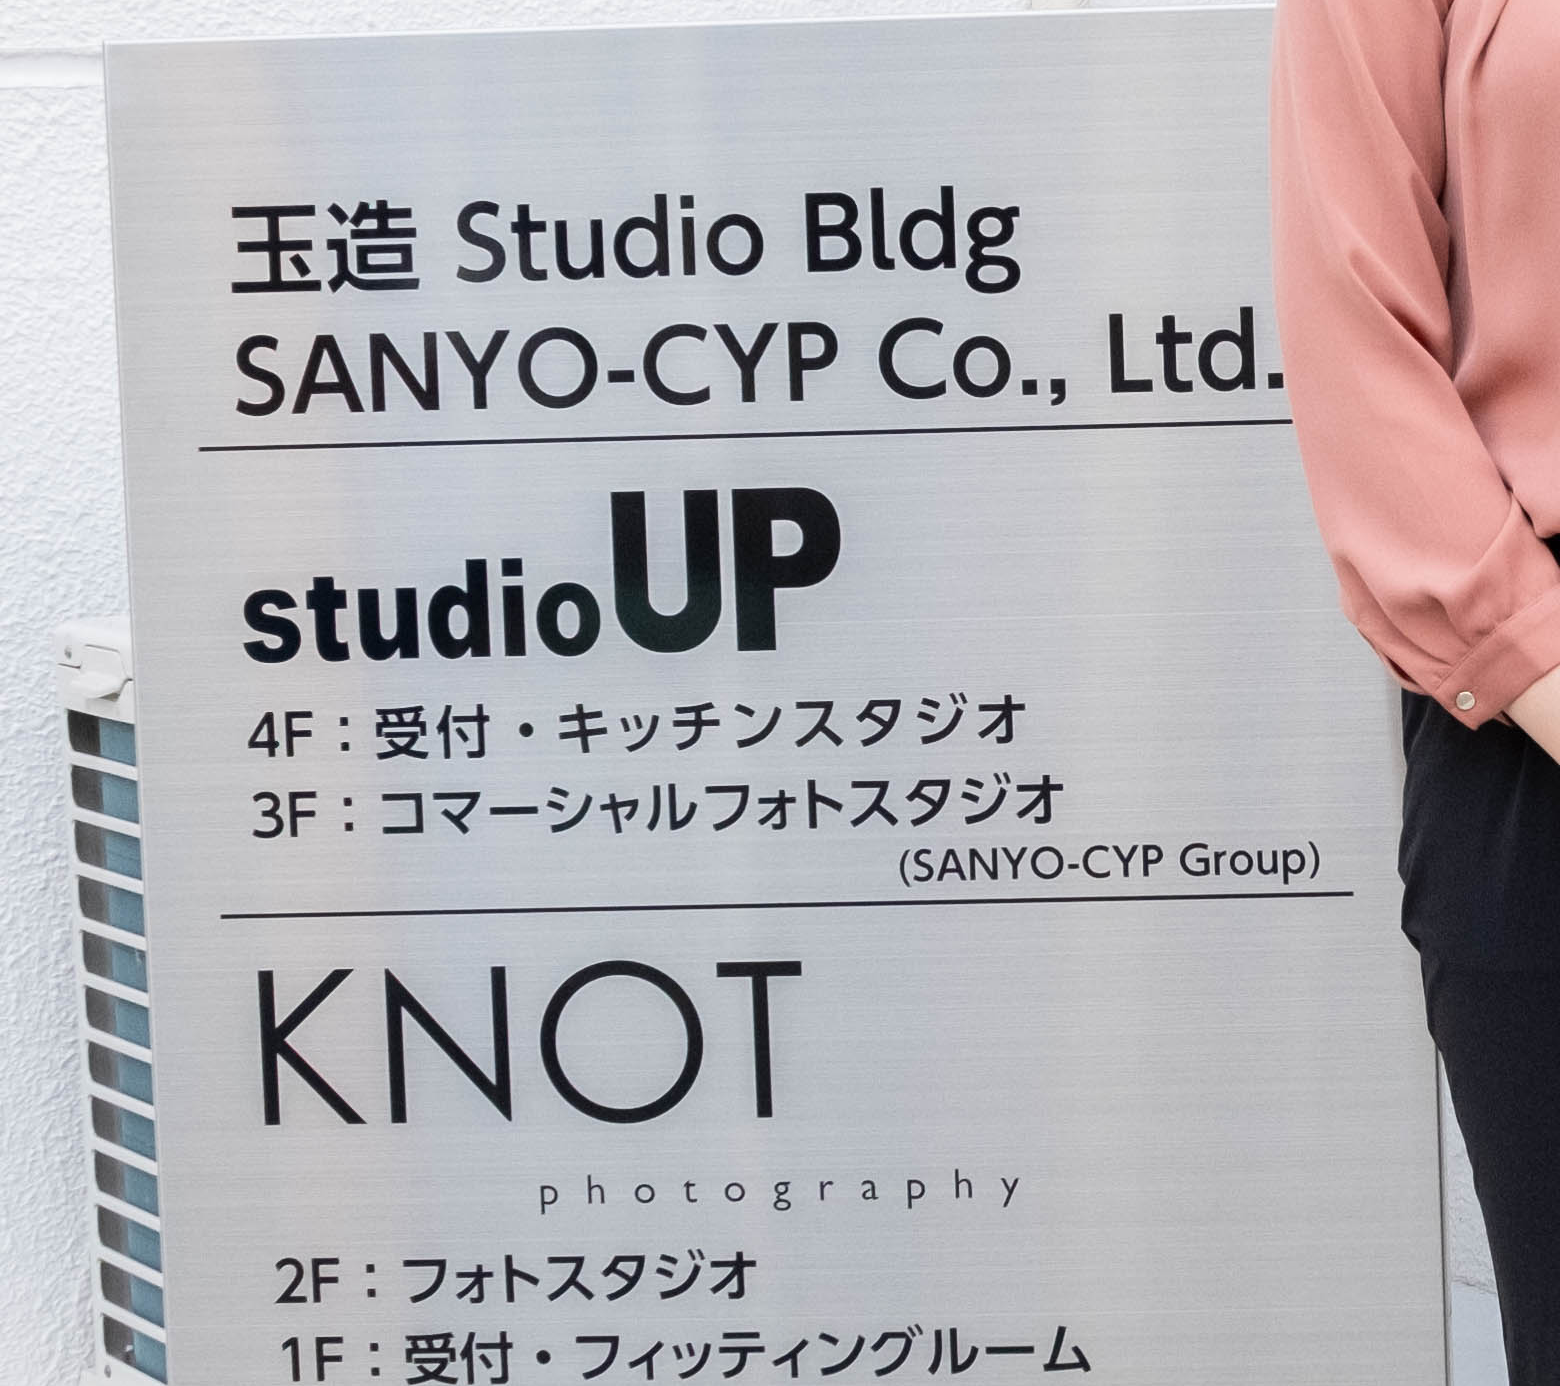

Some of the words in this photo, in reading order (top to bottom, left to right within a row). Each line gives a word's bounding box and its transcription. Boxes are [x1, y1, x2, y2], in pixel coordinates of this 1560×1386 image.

[231, 199, 420, 294] 玉造
[456, 193, 764, 283] Studio
[805, 185, 1021, 294] Bldg
[236, 321, 838, 417] SANYO-CYP
[878, 317, 1067, 406] Co.,
[1108, 306, 1285, 394] Ltd.
[243, 487, 841, 664] studioUP
[898, 844, 1164, 889] (SANYO-CYP
[1178, 840, 1321, 889] Group)
[257, 960, 803, 1126] KNOT
[539, 1167, 1020, 1215] photography
